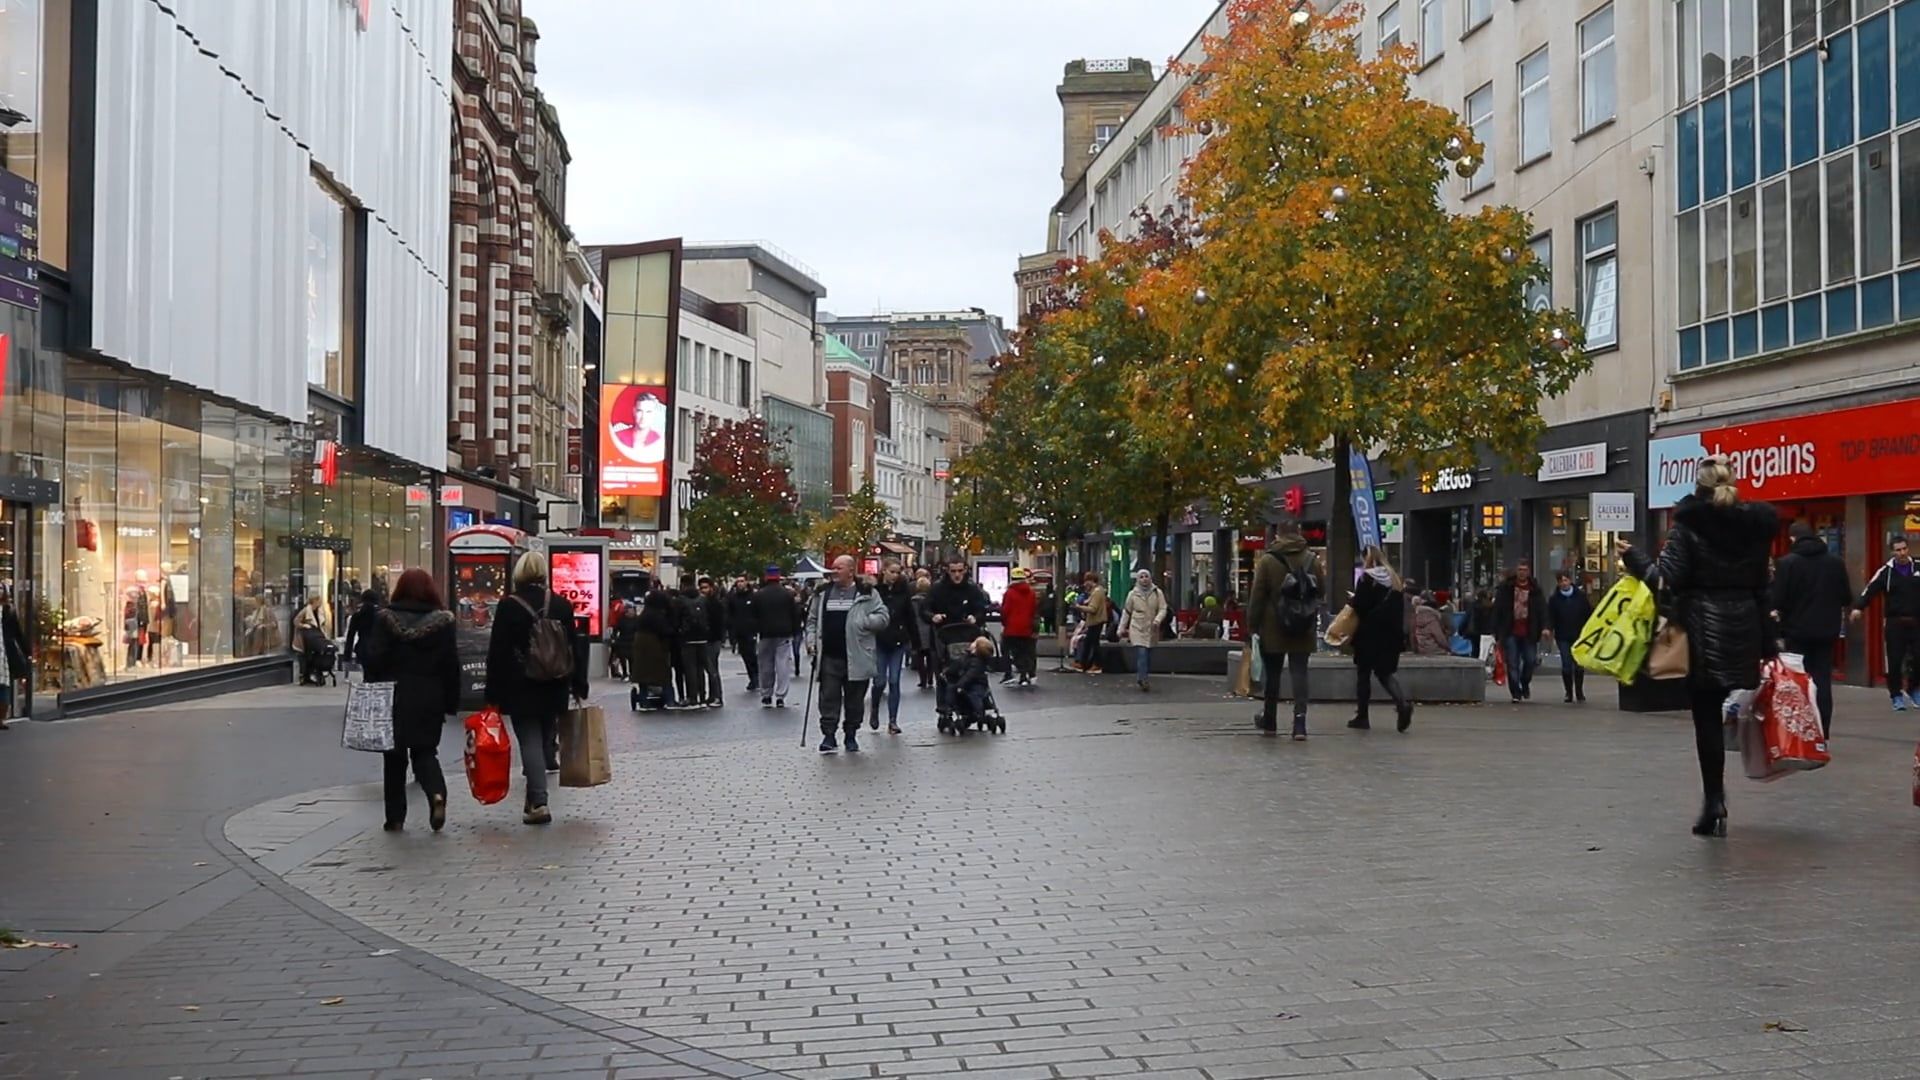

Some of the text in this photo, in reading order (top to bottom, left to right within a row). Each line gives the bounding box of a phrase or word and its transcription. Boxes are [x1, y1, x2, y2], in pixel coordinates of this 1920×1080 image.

[1549, 450, 1595, 474] CALENDAR CLUB
[1714, 435, 1816, 489] argains
[1840, 439, 1865, 463] TOP
[1356, 496, 1375, 545] GRE
[1597, 505, 1630, 514] CALENDAR
[572, 601, 591, 612] FF
